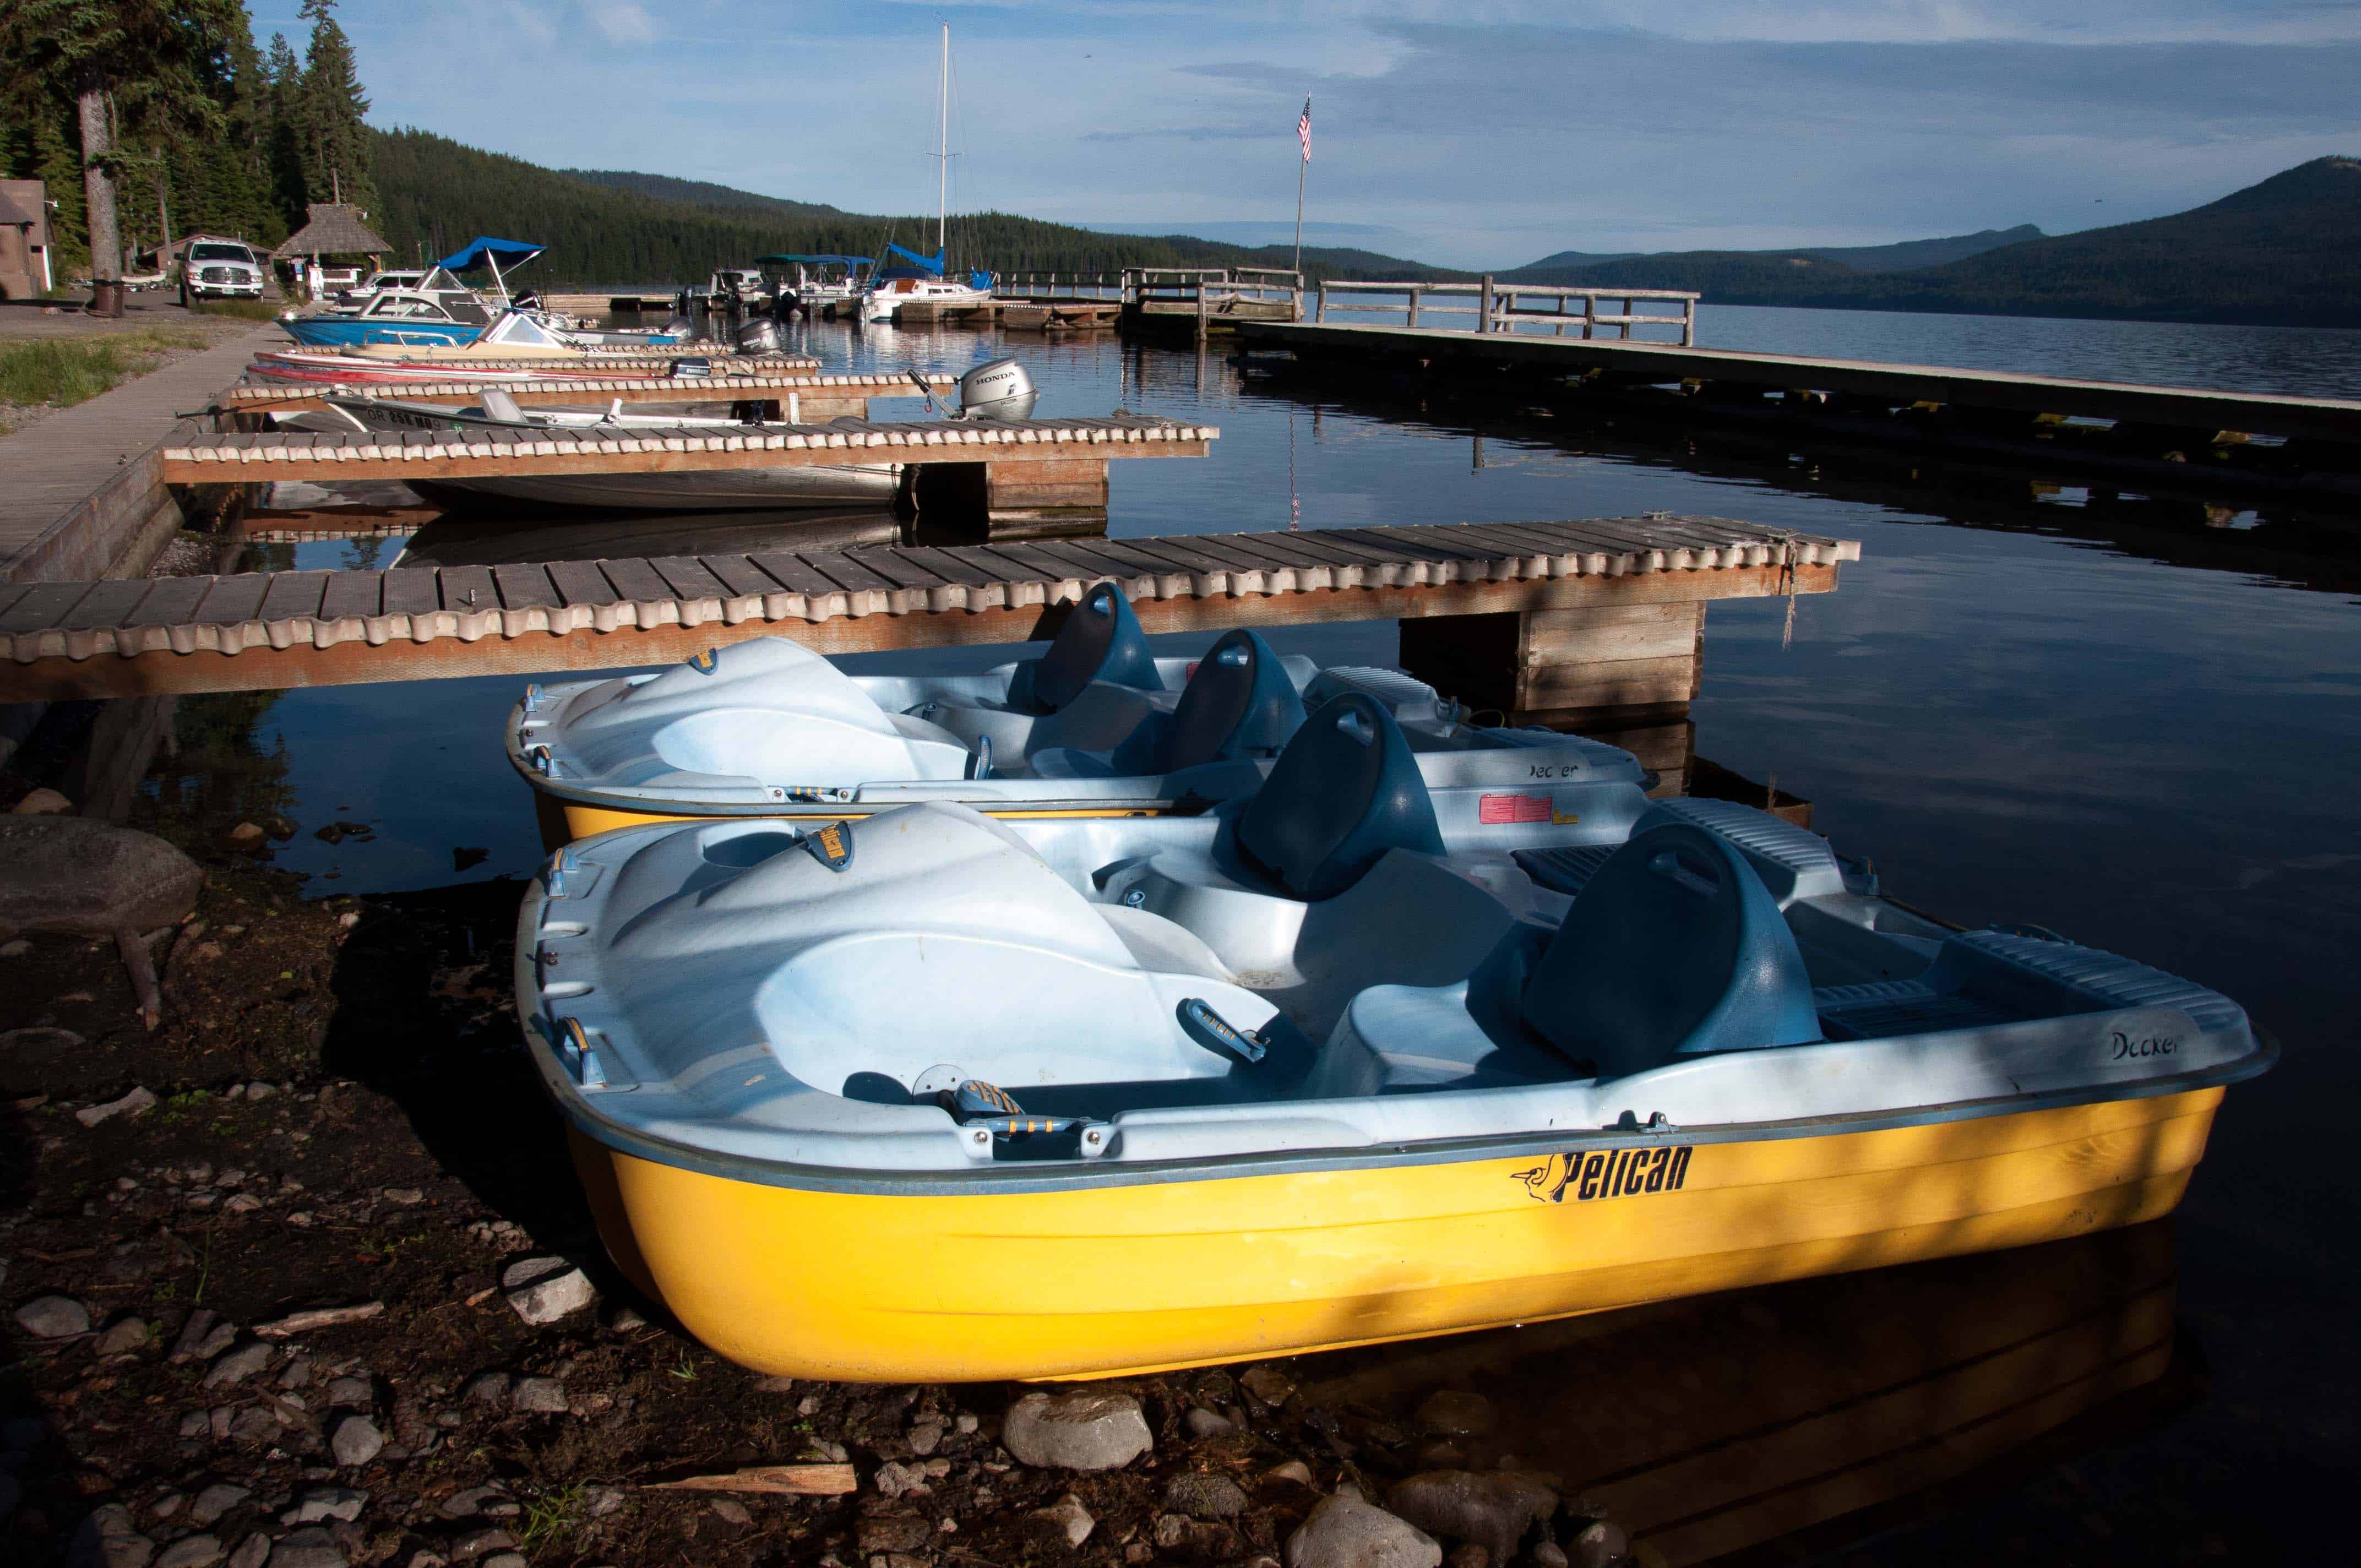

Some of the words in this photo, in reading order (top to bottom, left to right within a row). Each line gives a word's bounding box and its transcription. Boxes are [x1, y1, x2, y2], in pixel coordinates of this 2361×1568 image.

[976, 371, 1015, 385] HONDA
[367, 409, 386, 421] OR
[1530, 765, 1579, 778] ecer
[819, 823, 846, 859] elican
[1551, 1146, 1693, 1203] Pelican
